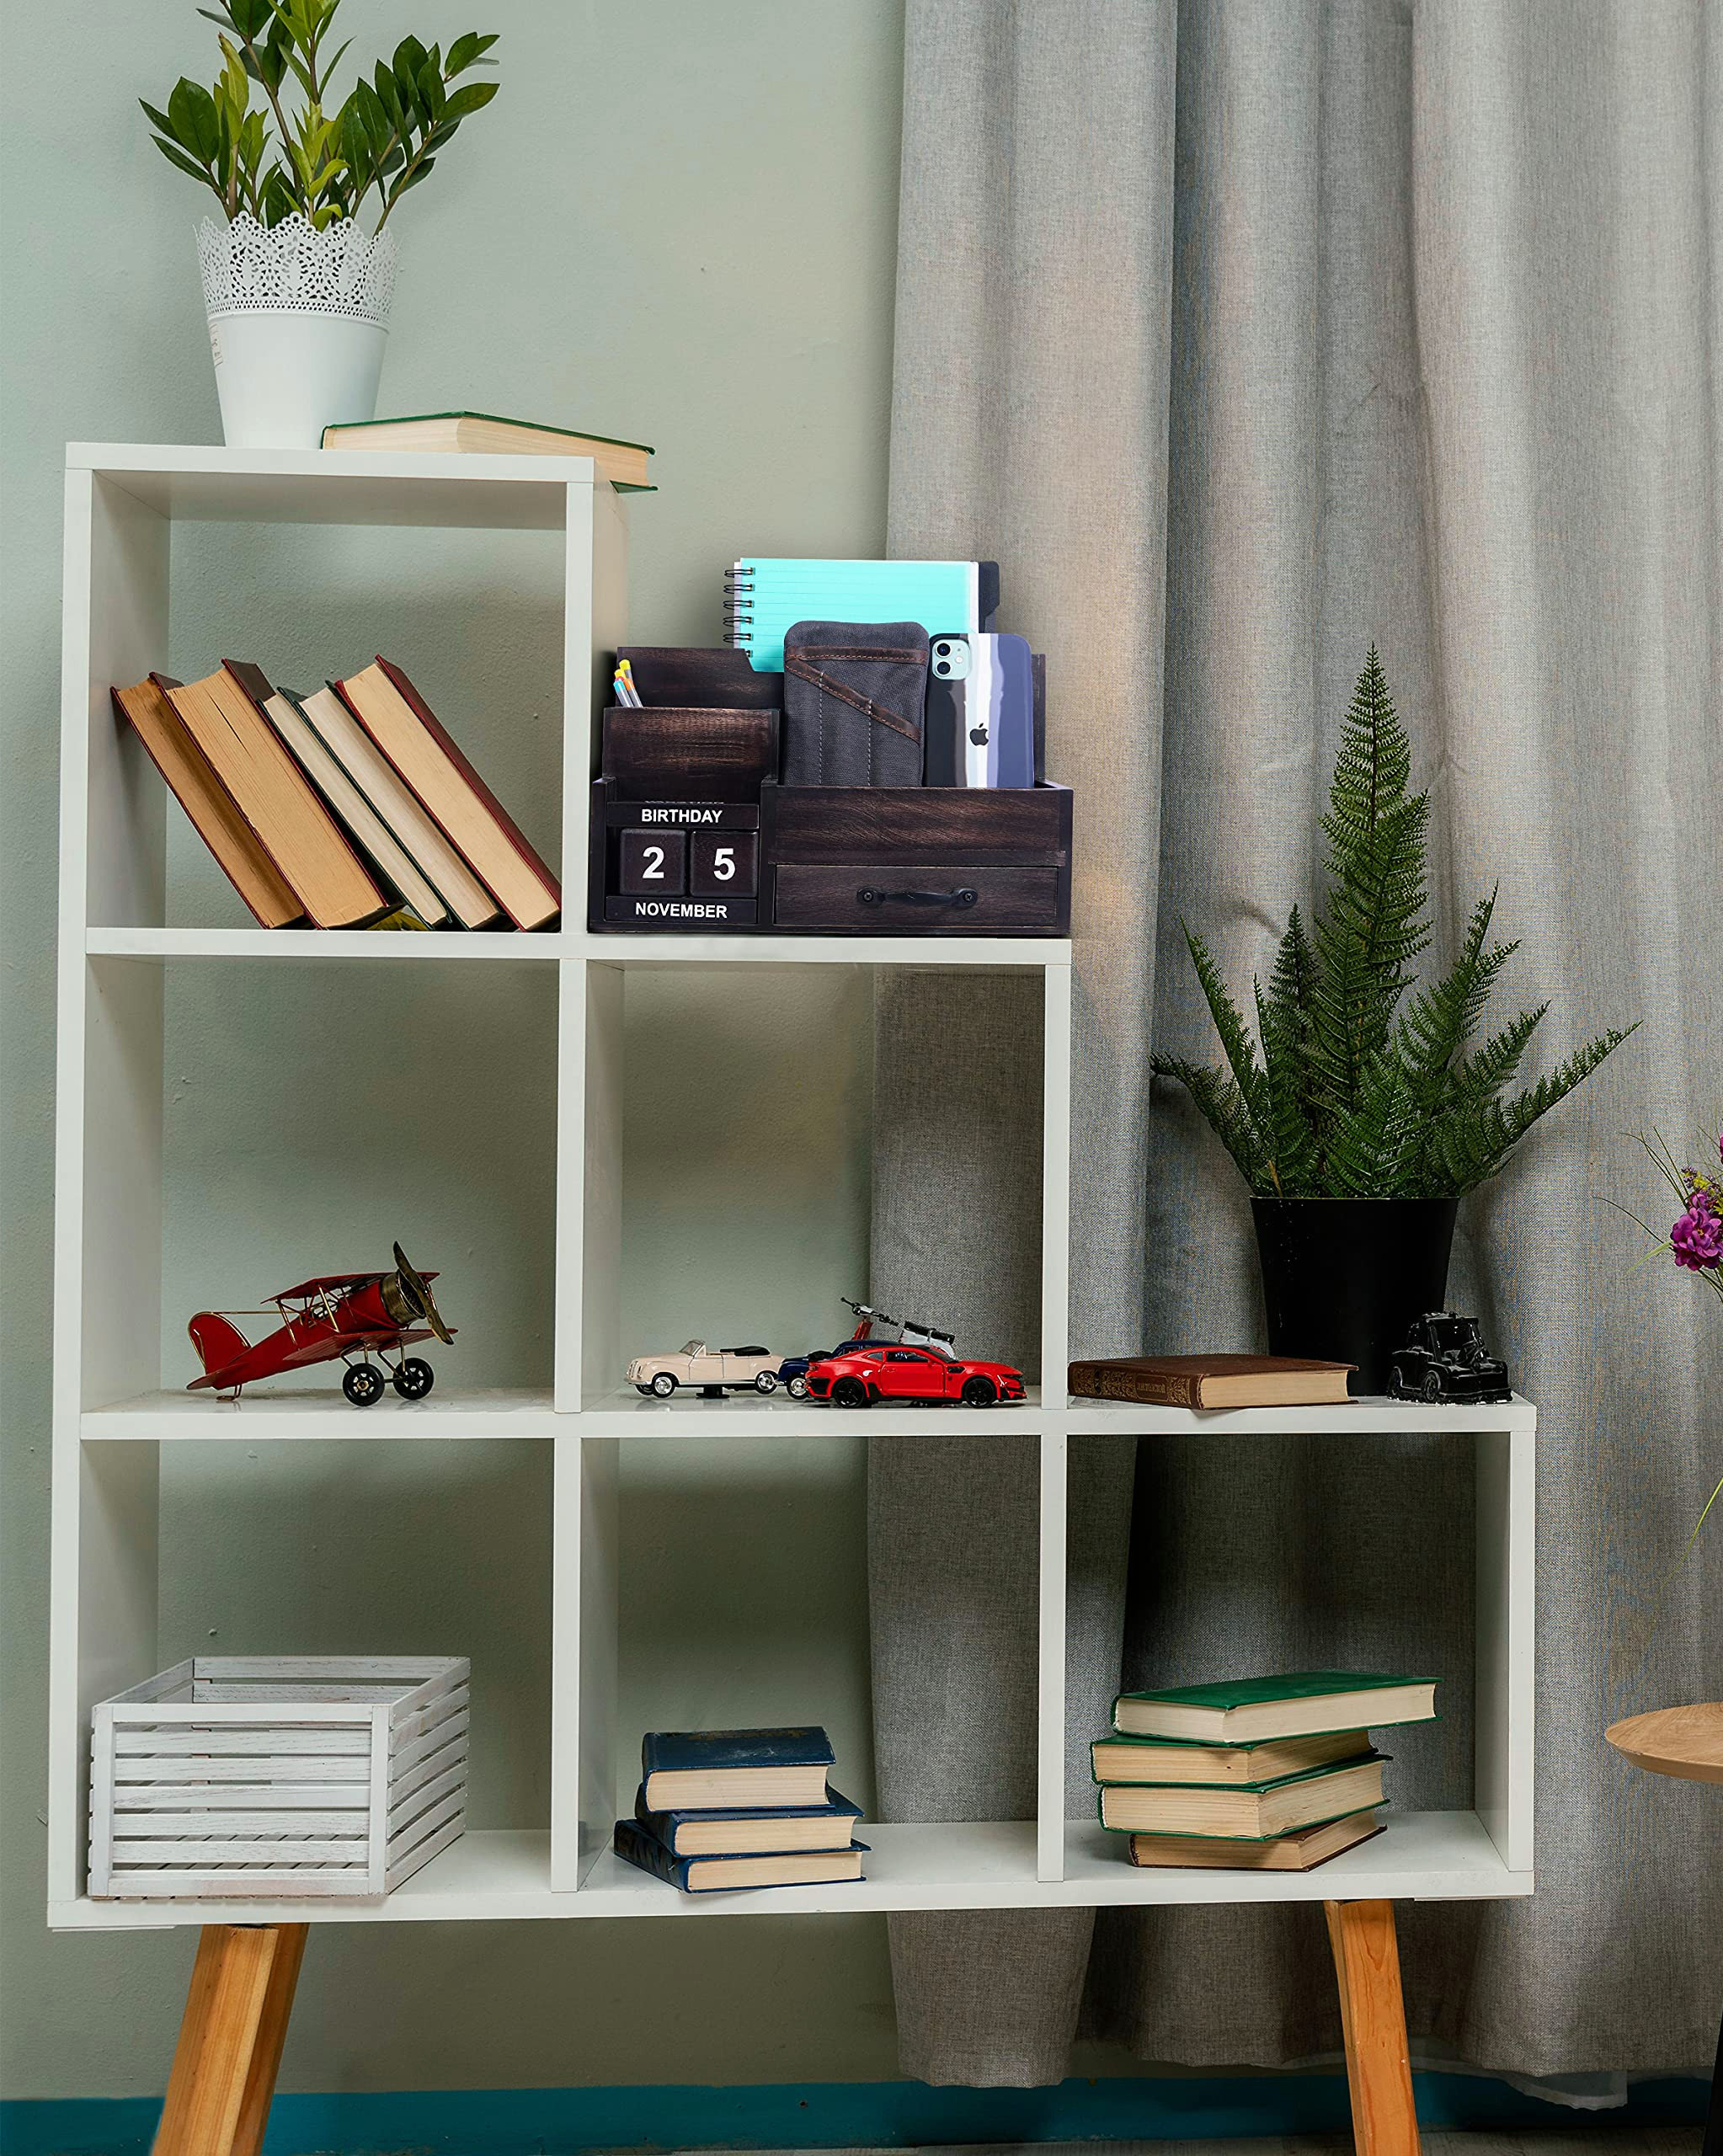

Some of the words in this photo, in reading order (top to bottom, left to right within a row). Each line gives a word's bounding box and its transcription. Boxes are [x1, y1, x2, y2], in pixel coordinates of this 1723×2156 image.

[641, 808, 723, 824] BIRTHDAY
[642, 846, 665, 879] 2
[713, 847, 736, 881] 5
[635, 902, 728, 919] NOVEMBER
